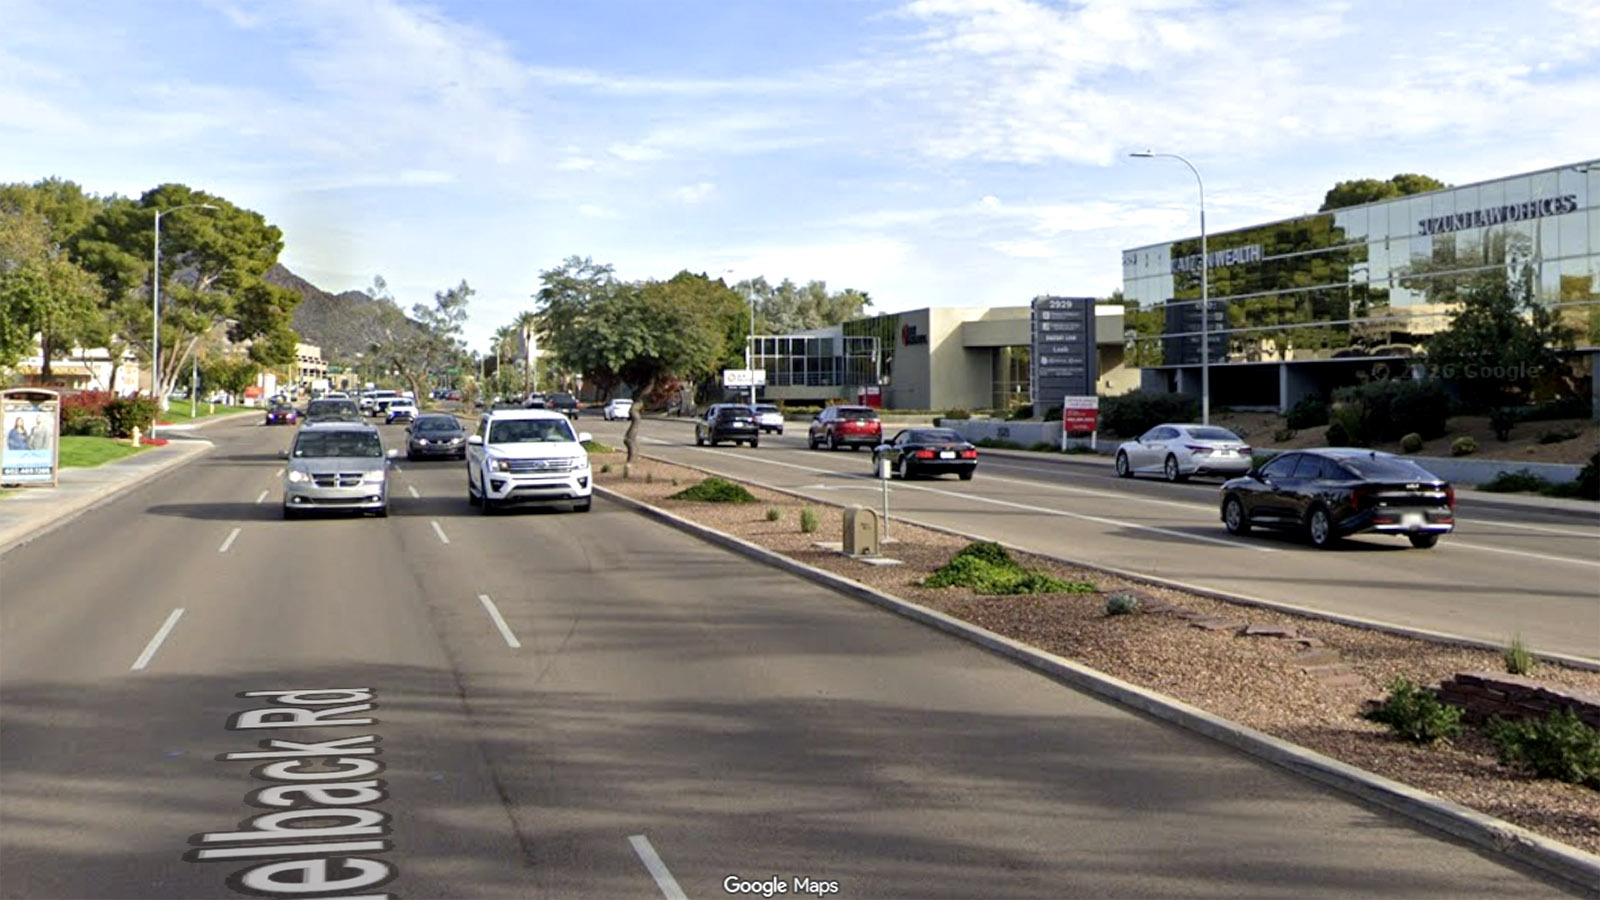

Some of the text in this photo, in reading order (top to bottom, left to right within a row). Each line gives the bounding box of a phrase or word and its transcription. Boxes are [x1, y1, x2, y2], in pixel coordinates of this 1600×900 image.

[1418, 194, 1577, 236] SUZUKI LAW OFFICES
[1215, 244, 1263, 267] WEALTH
[1049, 300, 1073, 309] 2929
